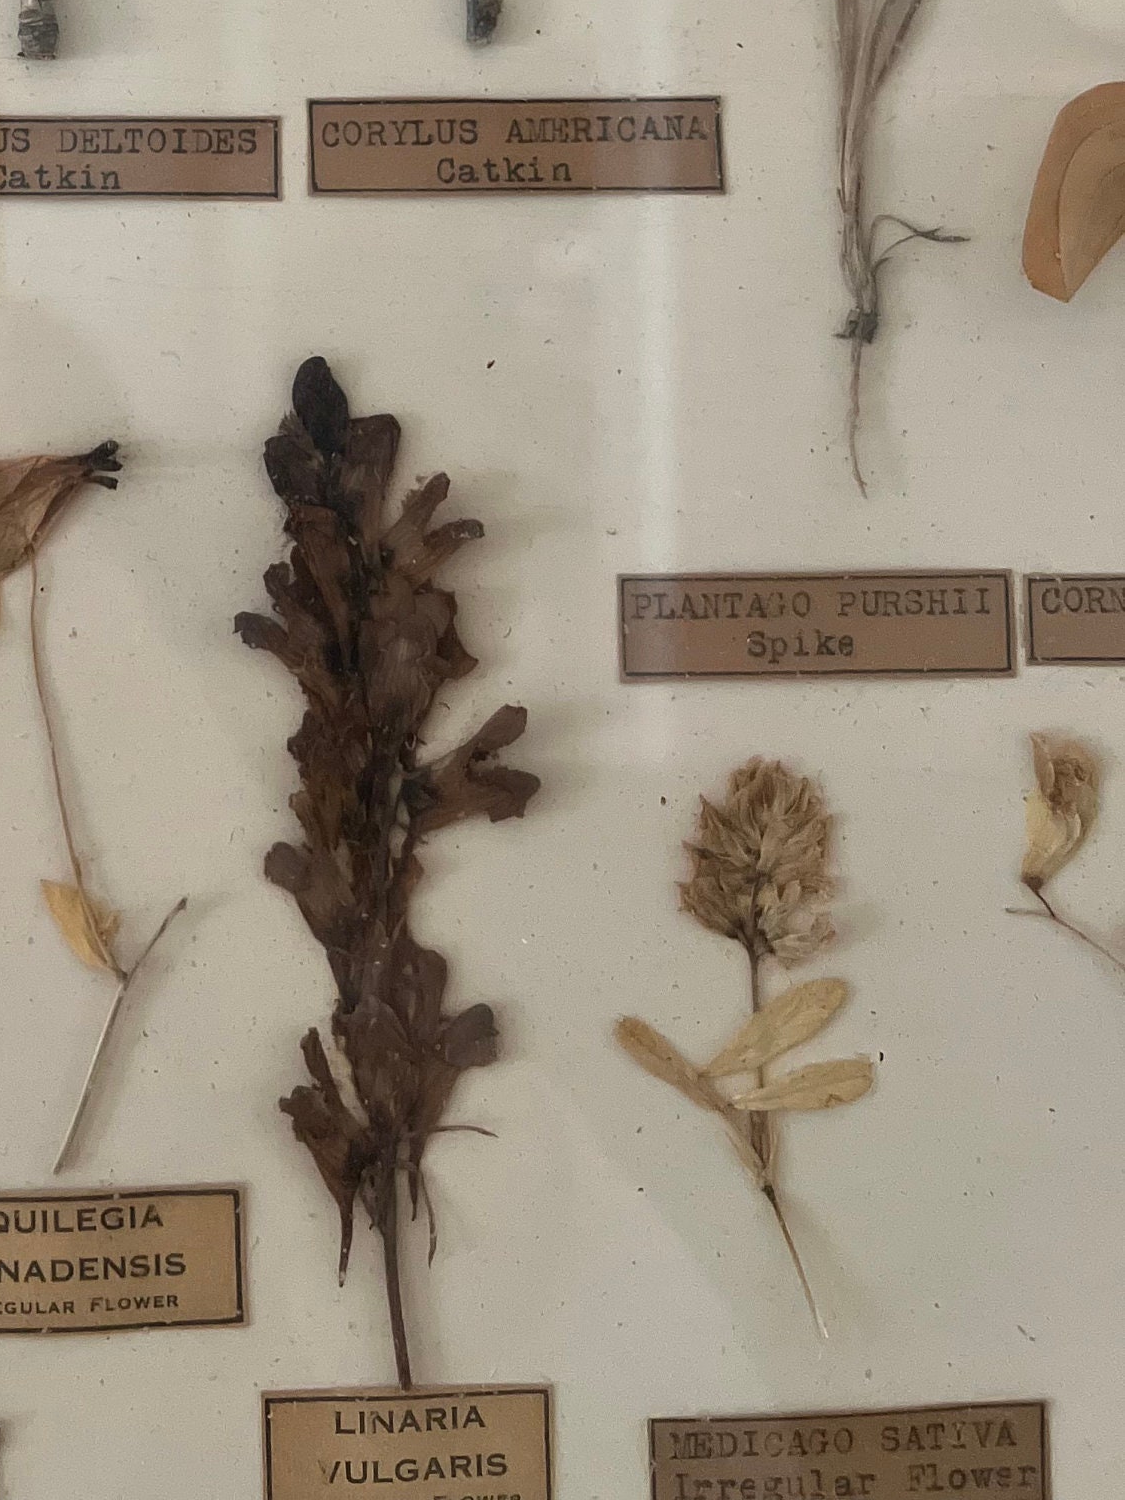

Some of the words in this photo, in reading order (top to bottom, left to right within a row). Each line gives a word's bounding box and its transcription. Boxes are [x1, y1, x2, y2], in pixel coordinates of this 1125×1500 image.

[55, 127, 257, 155] DELTOIDES
[322, 119, 479, 148] CORYLUS
[505, 115, 708, 145] AMERICANA
[437, 156, 572, 183] Catkin
[836, 587, 991, 617] PURSHII
[746, 629, 855, 664] Spike
[90, 1294, 180, 1313] FLOWER
[334, 1405, 487, 1435] LINARIA
[669, 1427, 854, 1461] MEDICAGO
[880, 1419, 1018, 1452] SATIVA
[318, 1452, 509, 1484] VULGARIS
[675, 1469, 877, 1500] Irregular
[908, 1463, 1038, 1492] Flower
